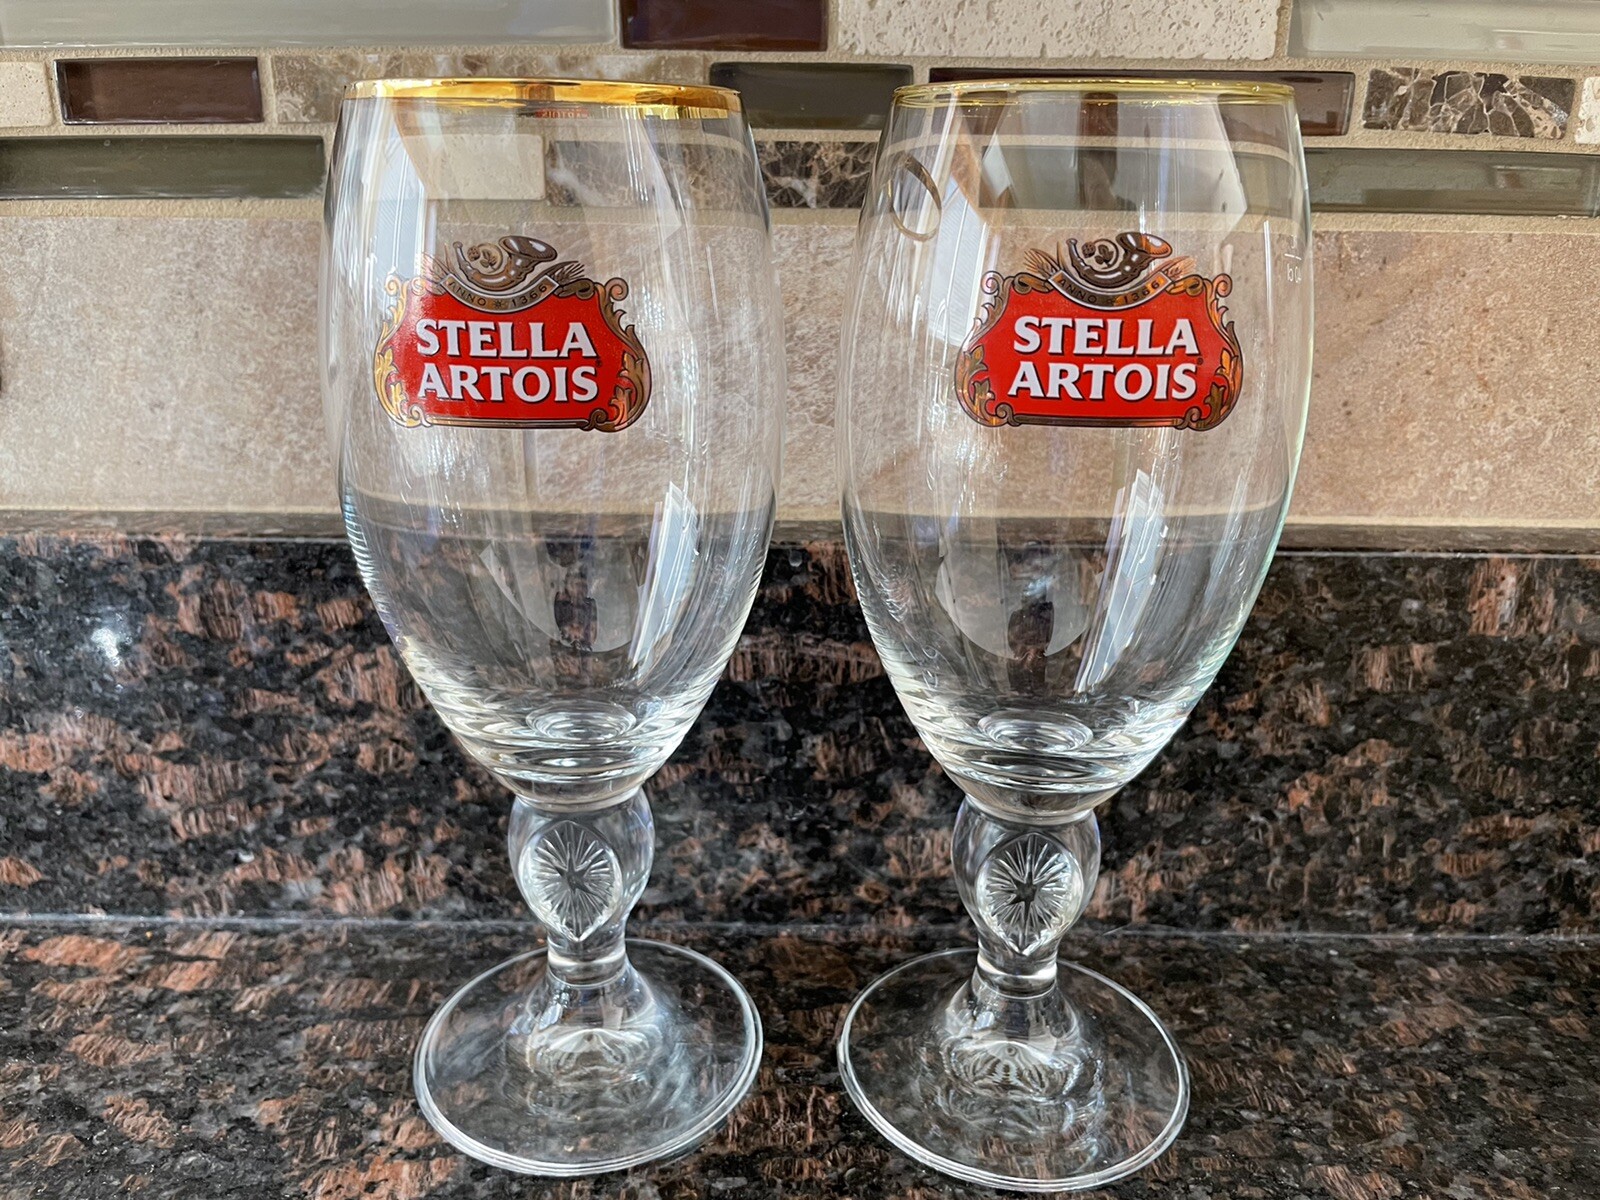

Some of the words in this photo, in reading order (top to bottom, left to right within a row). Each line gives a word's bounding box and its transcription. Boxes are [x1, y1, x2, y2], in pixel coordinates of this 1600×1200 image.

[448, 281, 487, 307] ANNO
[511, 284, 547, 307] 1366
[1057, 278, 1097, 304] ANNO
[1124, 280, 1160, 304] 1366
[415, 318, 597, 359] STELLA
[1013, 315, 1199, 356] STELLA
[417, 362, 599, 402] ARTOIS
[1007, 361, 1197, 401] ARTOIS
